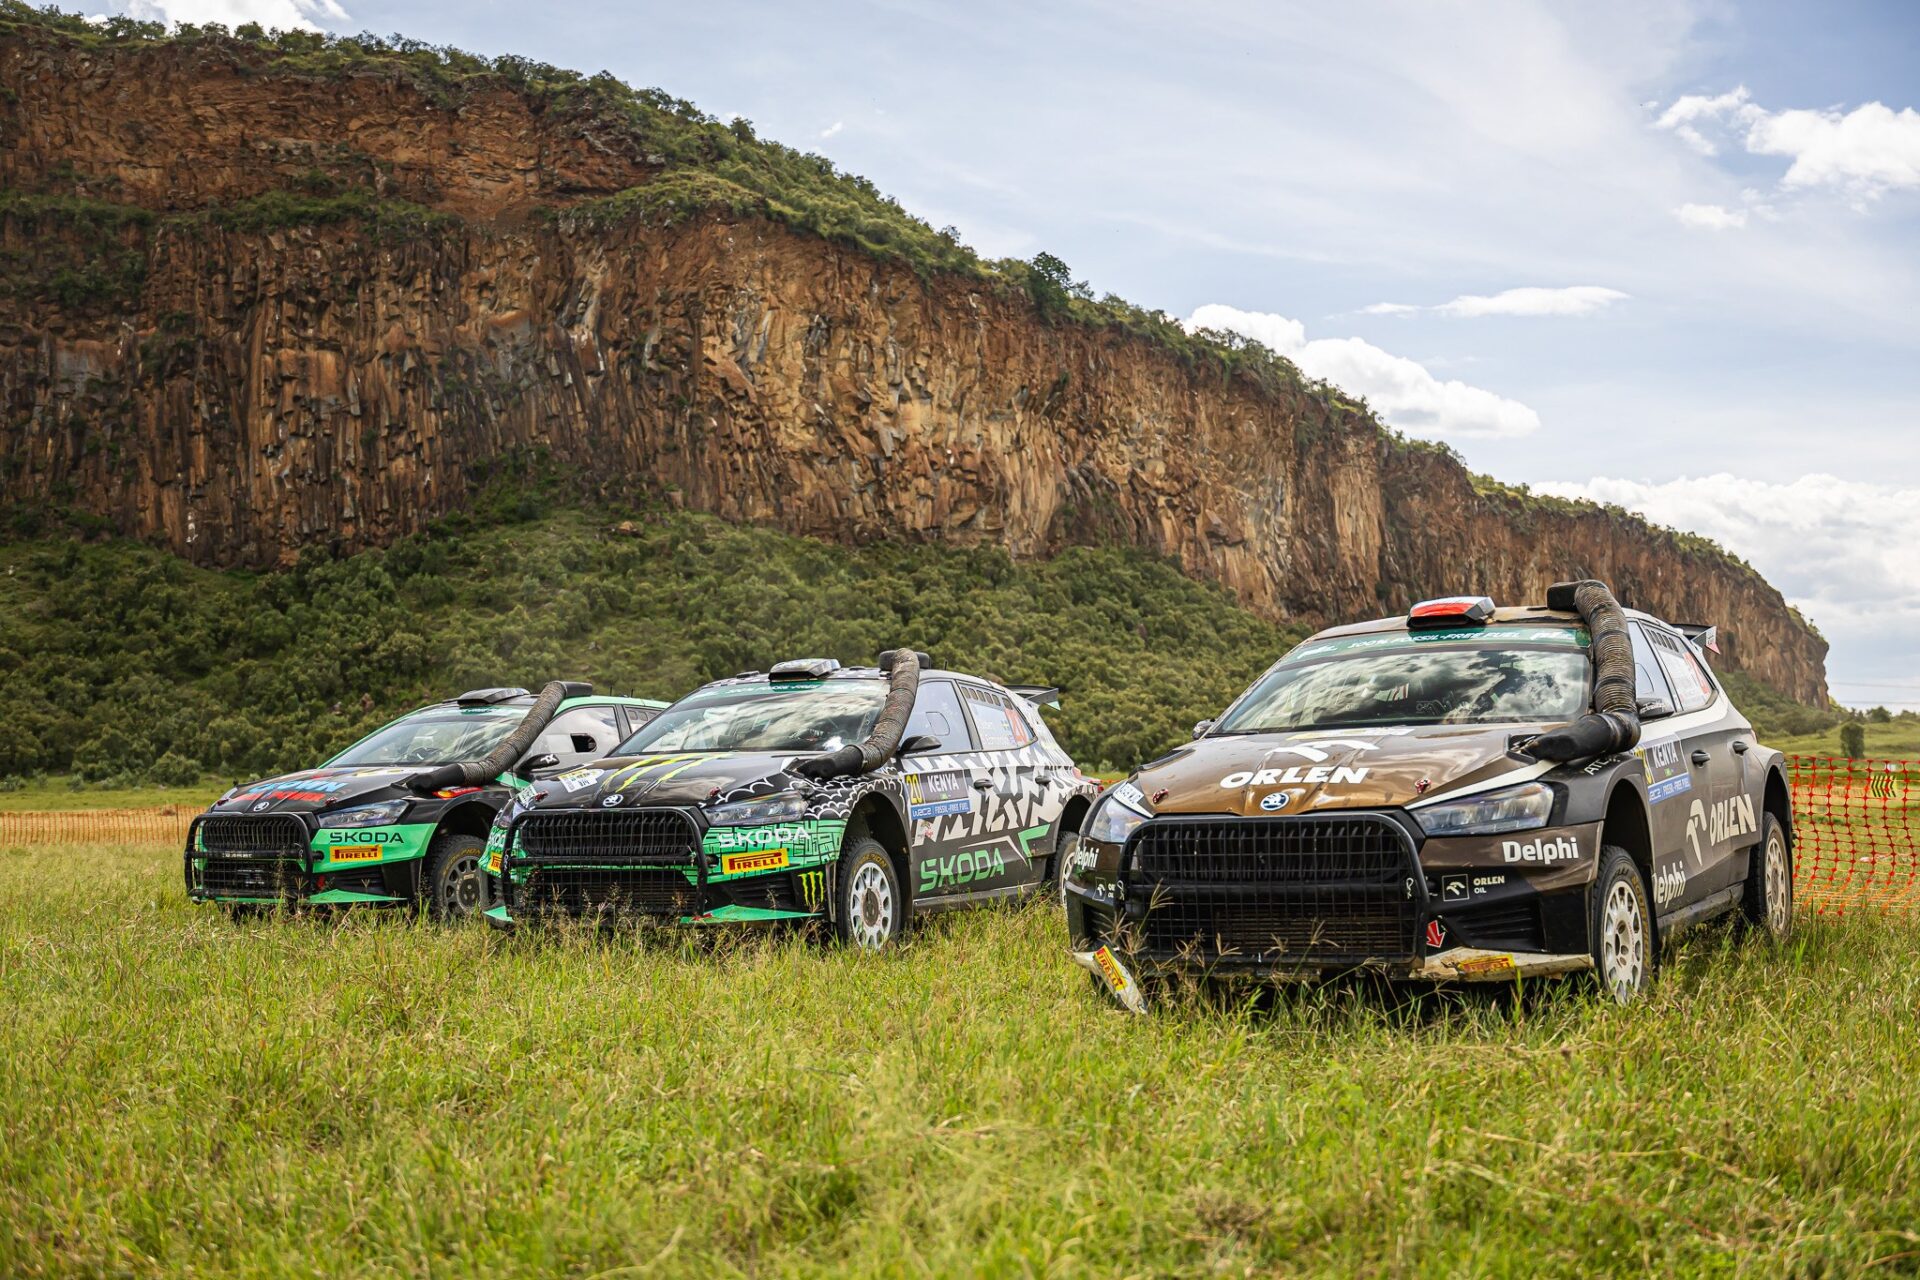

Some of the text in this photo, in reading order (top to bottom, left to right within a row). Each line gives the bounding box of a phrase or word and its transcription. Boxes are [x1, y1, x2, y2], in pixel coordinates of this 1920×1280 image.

[1652, 742, 1679, 768] KENYA
[906, 774, 922, 804] 20
[927, 773, 960, 793] KENYA
[1220, 766, 1370, 789] ORLEN
[1709, 793, 1757, 847] ORLEN
[334, 848, 377, 859] PIRELLI
[728, 852, 782, 871] PIRELLI
[1502, 836, 1579, 865] Delphi
[1473, 875, 1505, 886] ORLEN
